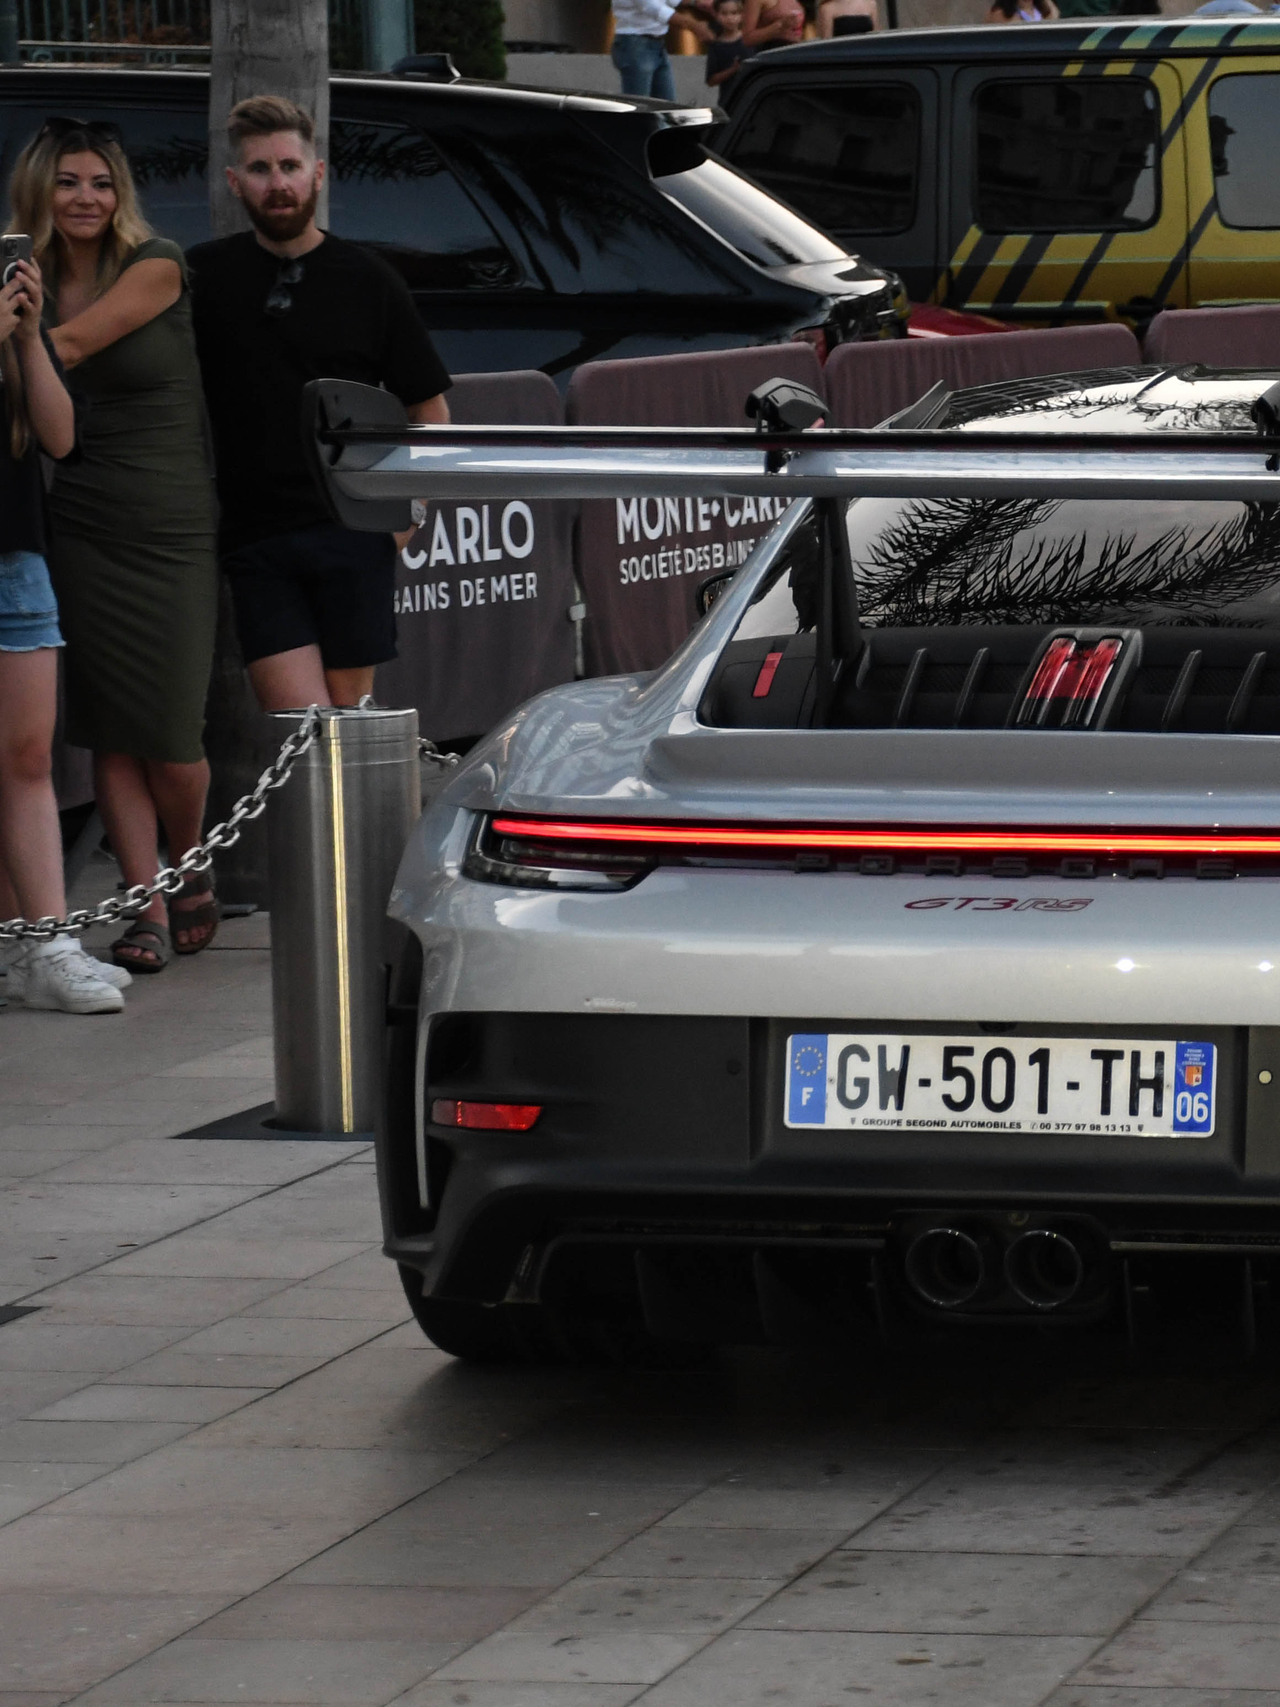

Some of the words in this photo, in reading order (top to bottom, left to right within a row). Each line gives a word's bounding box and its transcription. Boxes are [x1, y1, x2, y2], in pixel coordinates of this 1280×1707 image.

[619, 543, 682, 585] SOCIÉTÉ
[683, 545, 711, 574] DES
[459, 577, 486, 608] DE
[490, 572, 538, 603] MER
[801, 1087, 814, 1106] F
[836, 1043, 1166, 1118] GW-501-TH
[862, 1118, 902, 1126] GROUPE
[906, 1119, 947, 1127] SEGOND
[951, 1120, 1022, 1129] AUTOMOBILES
[1176, 1091, 1209, 1123] 06
